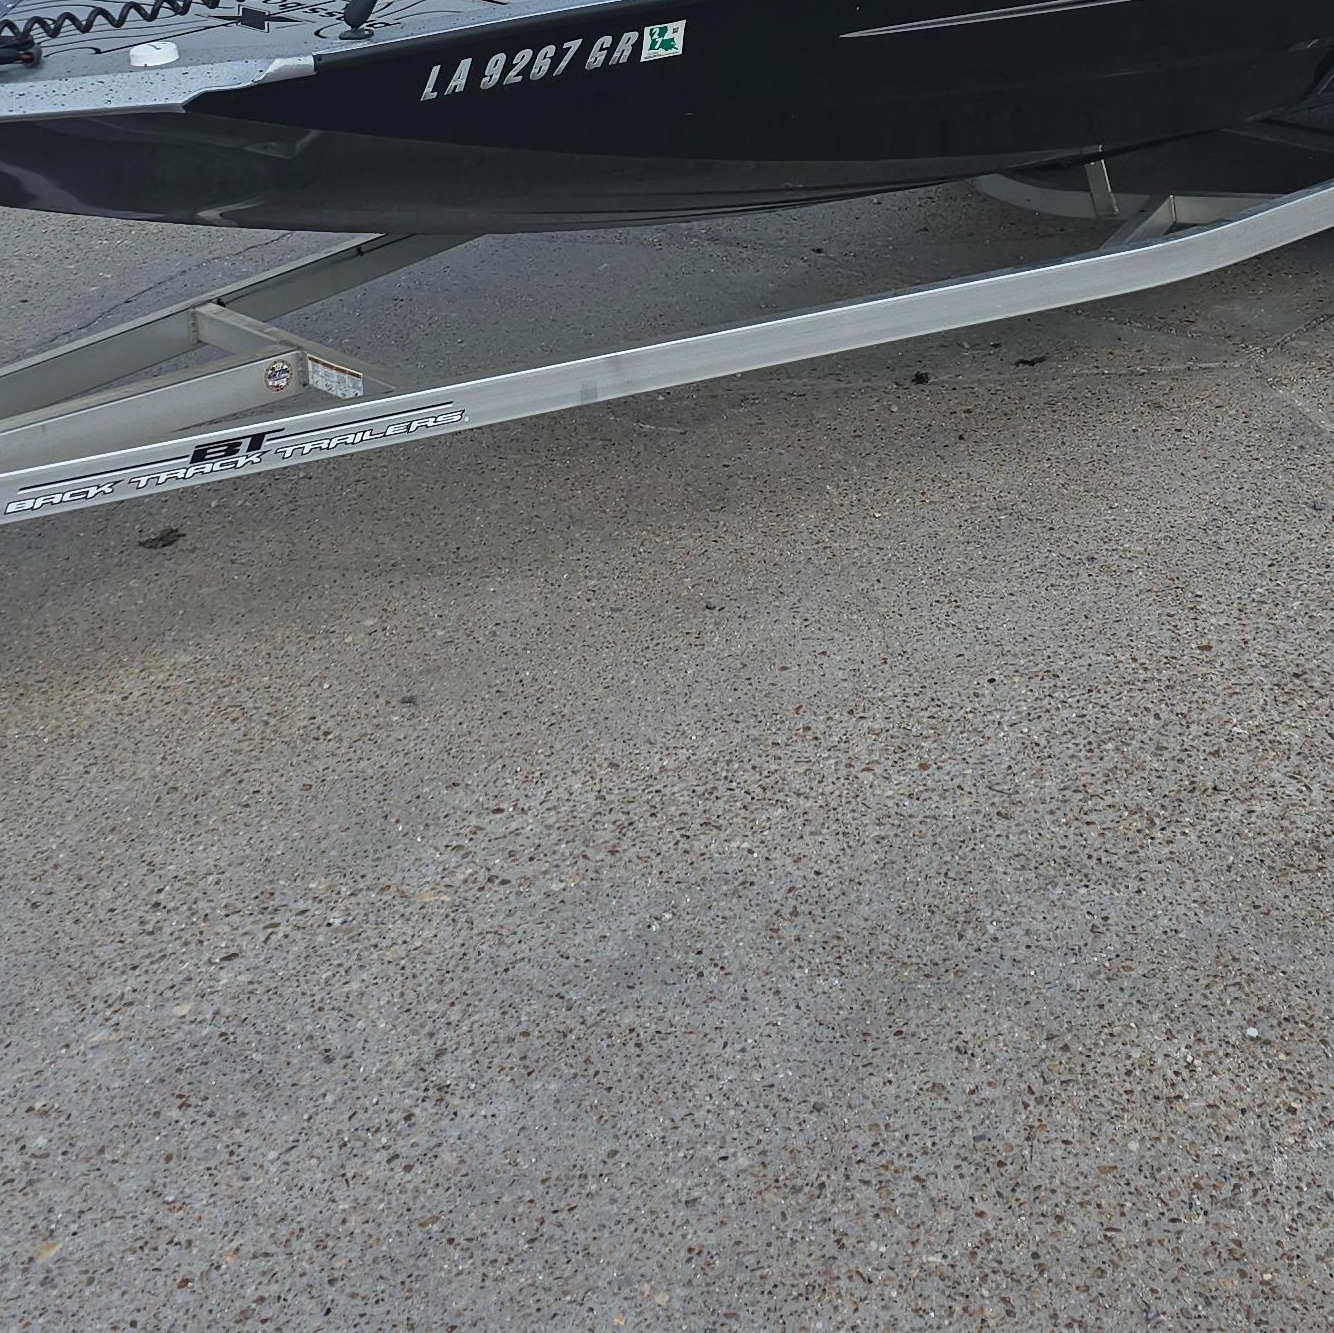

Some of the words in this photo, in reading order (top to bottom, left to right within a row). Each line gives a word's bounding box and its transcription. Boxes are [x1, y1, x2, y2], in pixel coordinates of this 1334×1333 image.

[420, 57, 473, 102] LA
[479, 38, 583, 90] 9267
[584, 31, 640, 71] GR
[4, 480, 123, 515] BACK
[129, 449, 268, 491] TRACK
[276, 409, 465, 460] TRAILERS
[189, 427, 286, 465] BT
